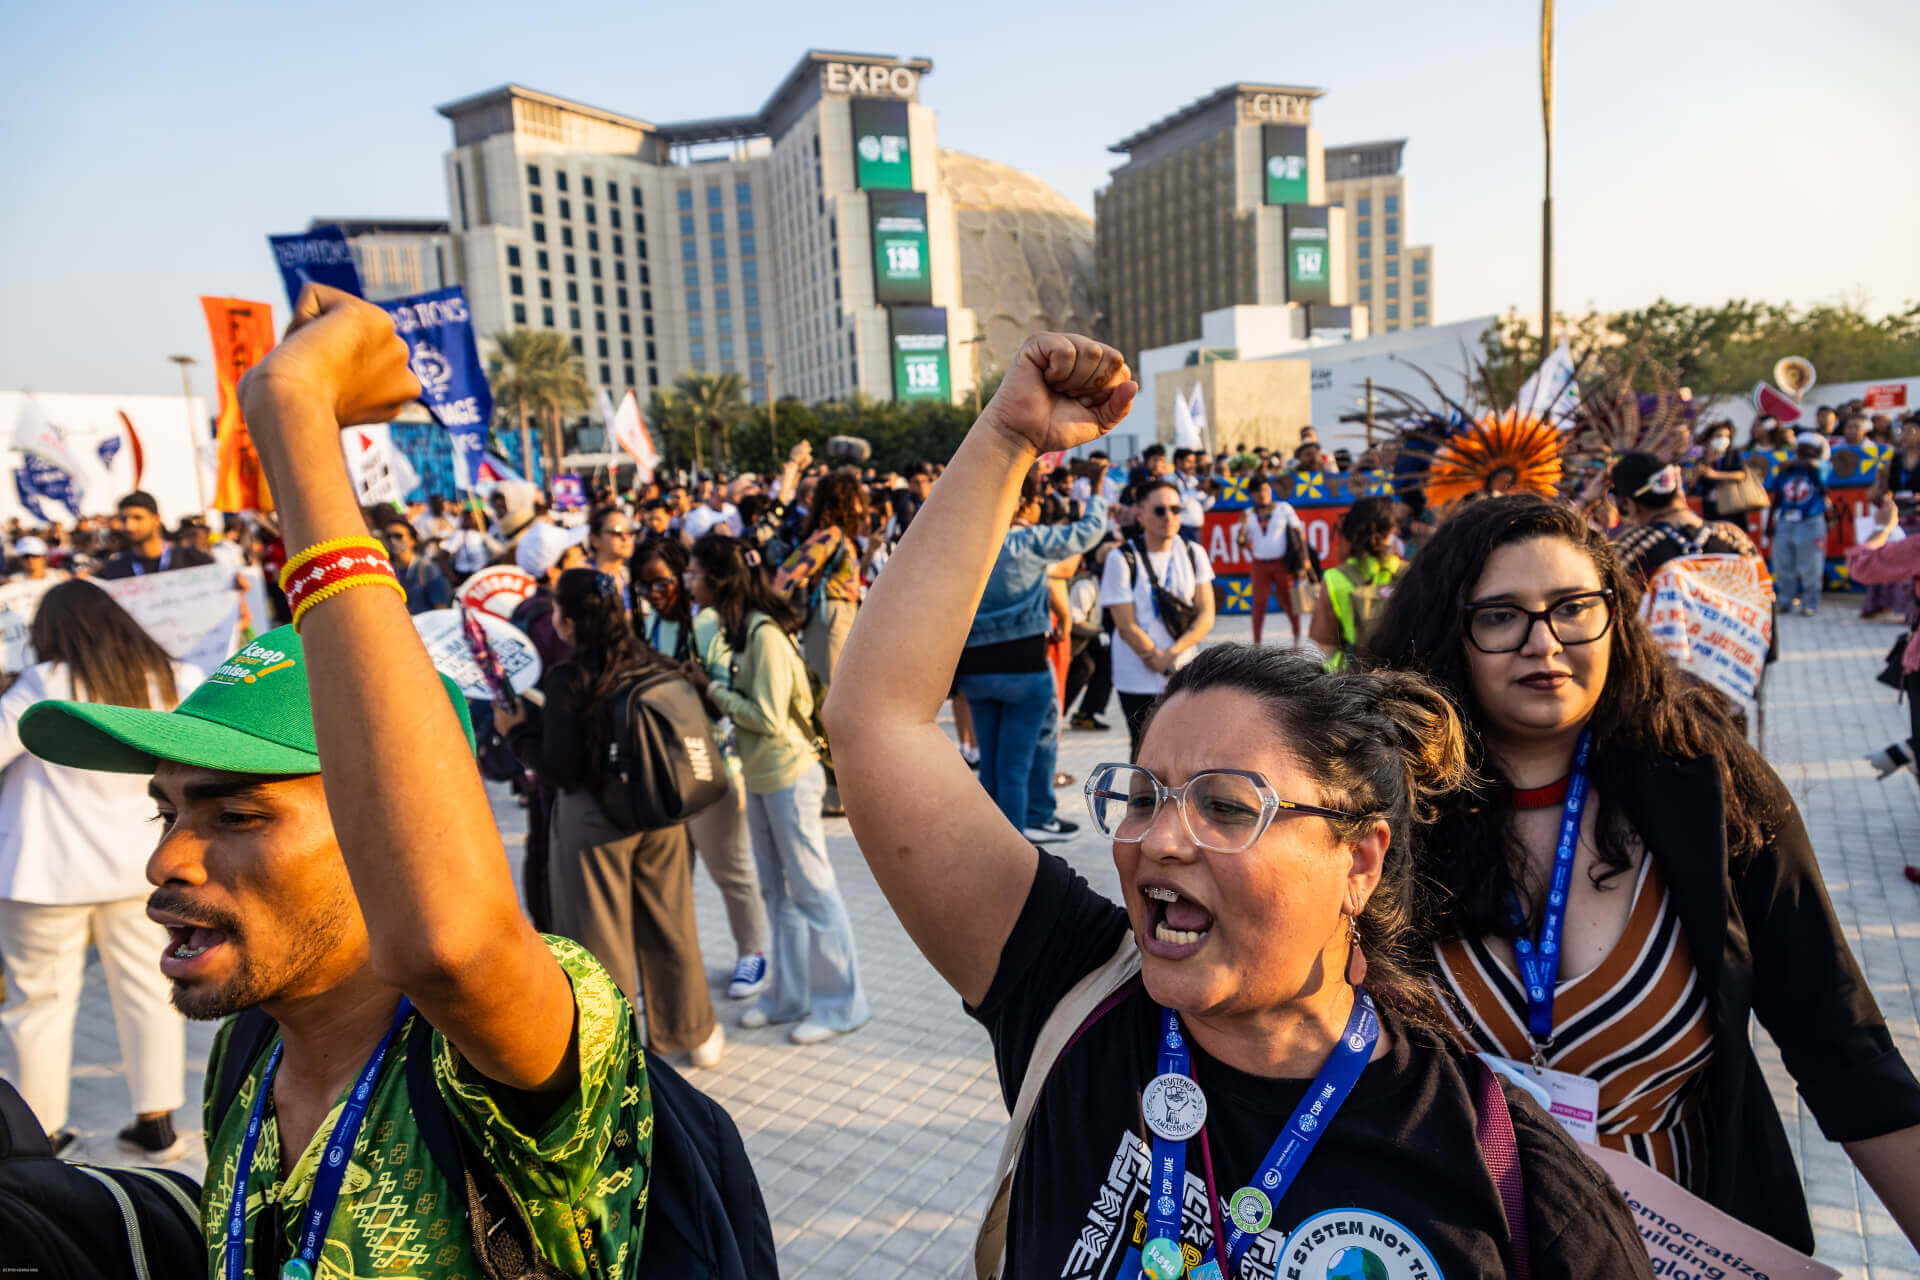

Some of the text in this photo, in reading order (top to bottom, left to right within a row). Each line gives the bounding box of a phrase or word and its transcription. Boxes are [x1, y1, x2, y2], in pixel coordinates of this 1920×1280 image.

[826, 62, 916, 97] EXPO
[1253, 93, 1308, 121] CITY
[905, 363, 939, 387] 135
[241, 641, 285, 665] keep
[684, 736, 713, 781] NIKE
[1293, 1220, 1364, 1265] SYSTEM
[1369, 1224, 1411, 1257] NOT
[1408, 1257, 1429, 1280] TH
[1637, 1223, 1726, 1280] uilding
[1651, 1256, 1702, 1280] glo
